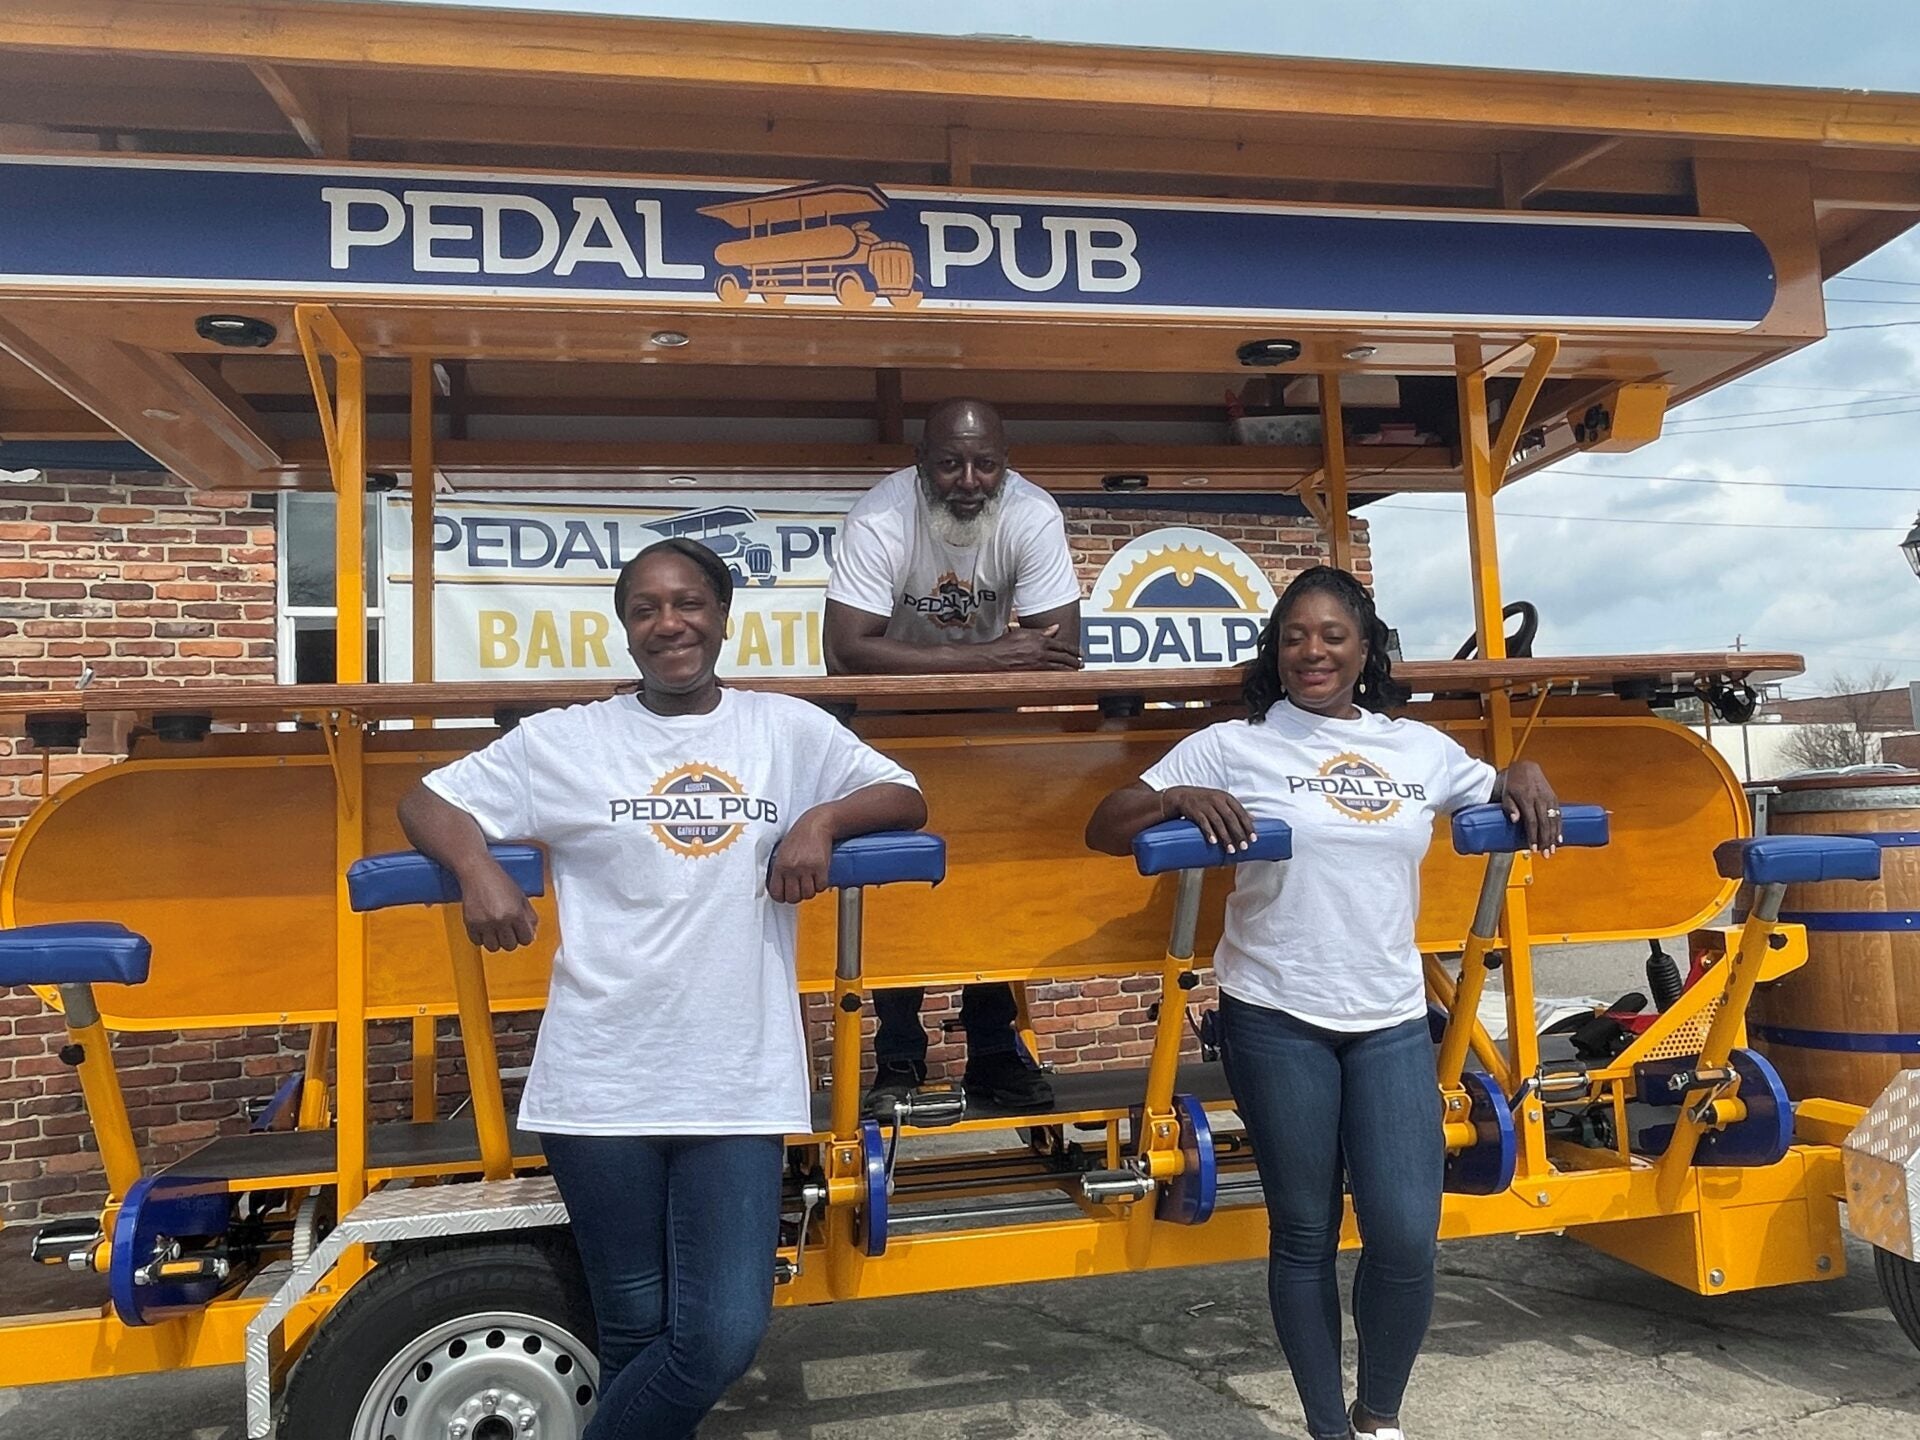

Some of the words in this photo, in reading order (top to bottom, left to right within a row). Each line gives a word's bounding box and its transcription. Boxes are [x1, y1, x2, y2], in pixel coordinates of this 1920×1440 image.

[321, 186, 706, 281] PEDAL
[920, 210, 1142, 294] PUB
[904, 593, 962, 613] PEDAL
[478, 610, 612, 669] BAR
[726, 611, 822, 667] ATI
[1081, 617, 1222, 663] EDAL
[1286, 775, 1374, 797] PEDAL
[1374, 780, 1427, 801] PUB
[609, 797, 714, 822] PEDAL
[718, 797, 778, 824] PUB
